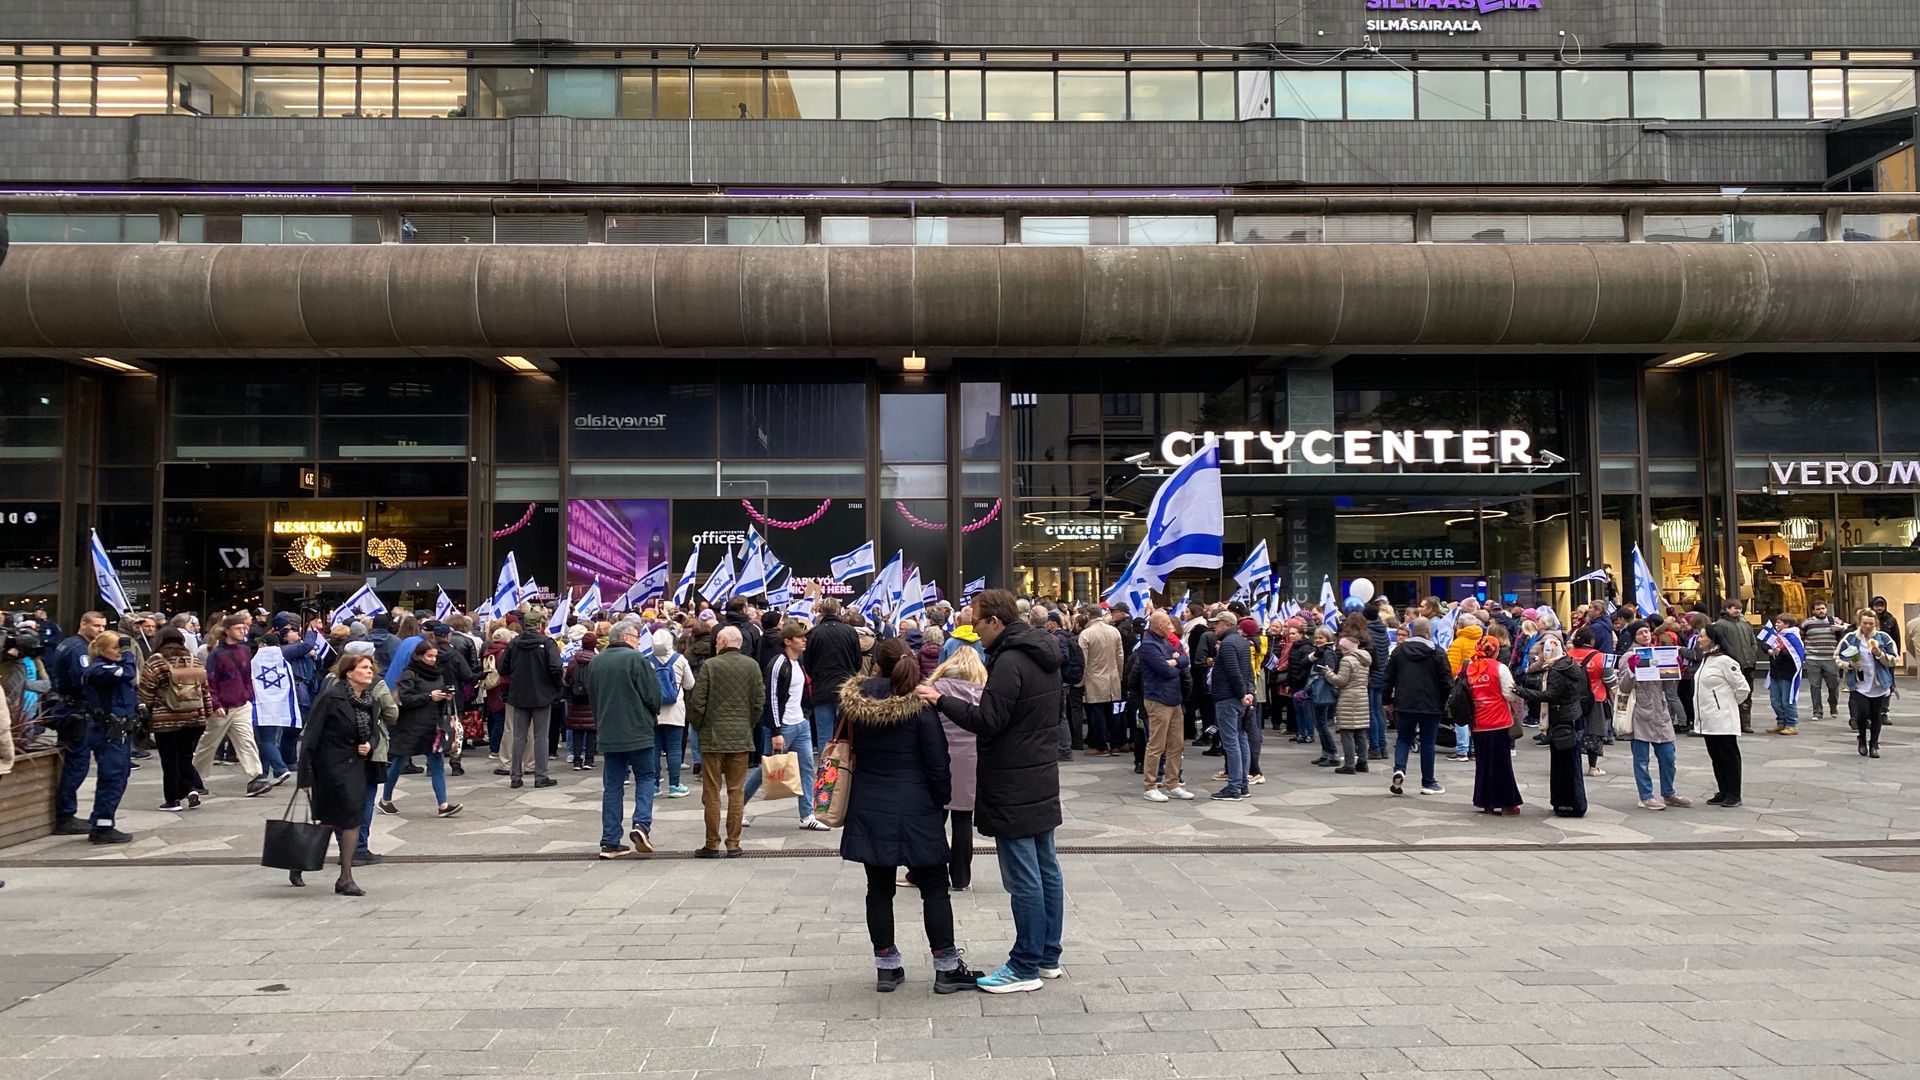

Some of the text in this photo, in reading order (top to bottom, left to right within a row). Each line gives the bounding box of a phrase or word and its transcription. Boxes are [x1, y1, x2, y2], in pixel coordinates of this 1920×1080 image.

[1772, 460, 1879, 485] VERO
[304, 472, 315, 486] 6E
[274, 521, 364, 533] KESKUSKATU
[692, 531, 746, 544] offices
[1353, 549, 1454, 559] CITYCENTER
[1391, 559, 1427, 567] shopping
[827, 586, 855, 594] HERE.
